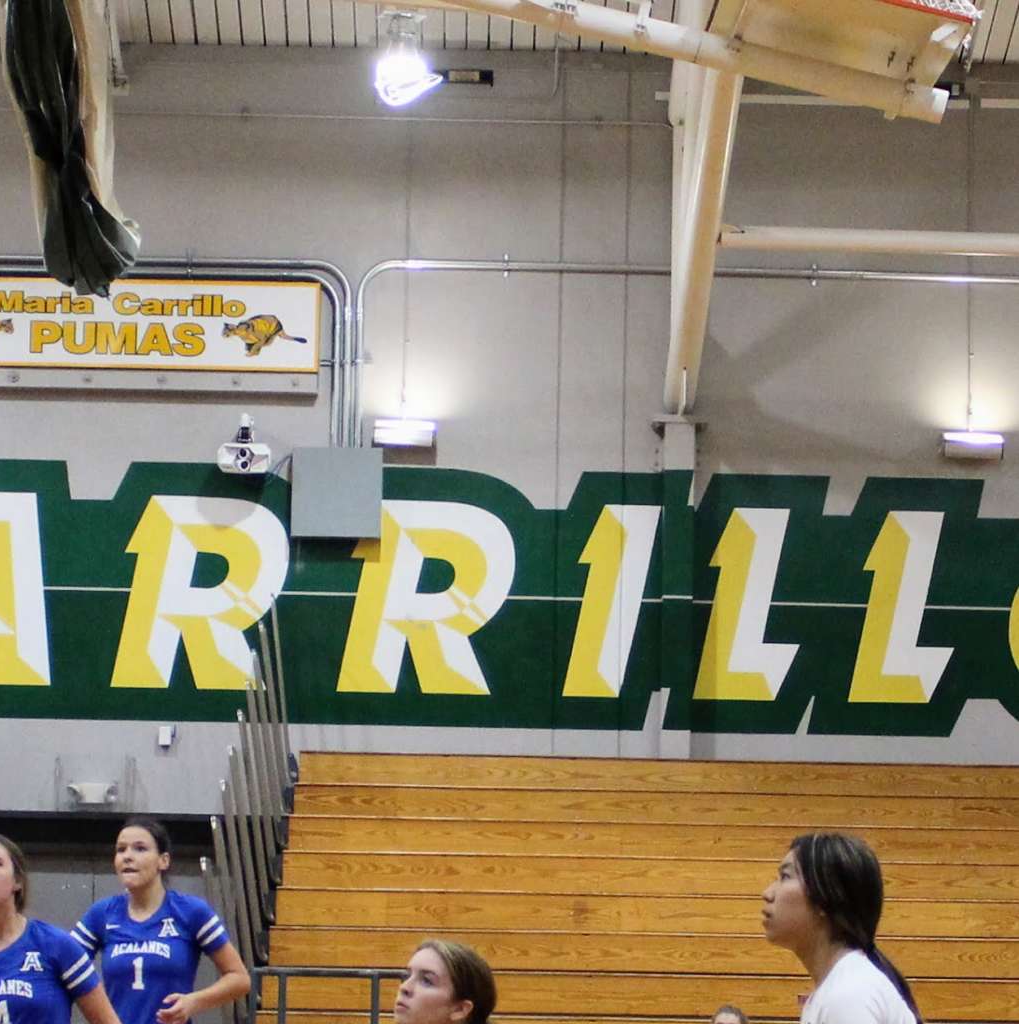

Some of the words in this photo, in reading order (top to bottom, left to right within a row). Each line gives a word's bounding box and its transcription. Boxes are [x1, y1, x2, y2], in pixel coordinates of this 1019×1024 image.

[112, 292, 246, 318] Carrillo
[29, 321, 206, 357] PUMAS
[19, 951, 44, 972] A
[110, 940, 171, 959] ACALANES
[131, 956, 145, 990] 1
